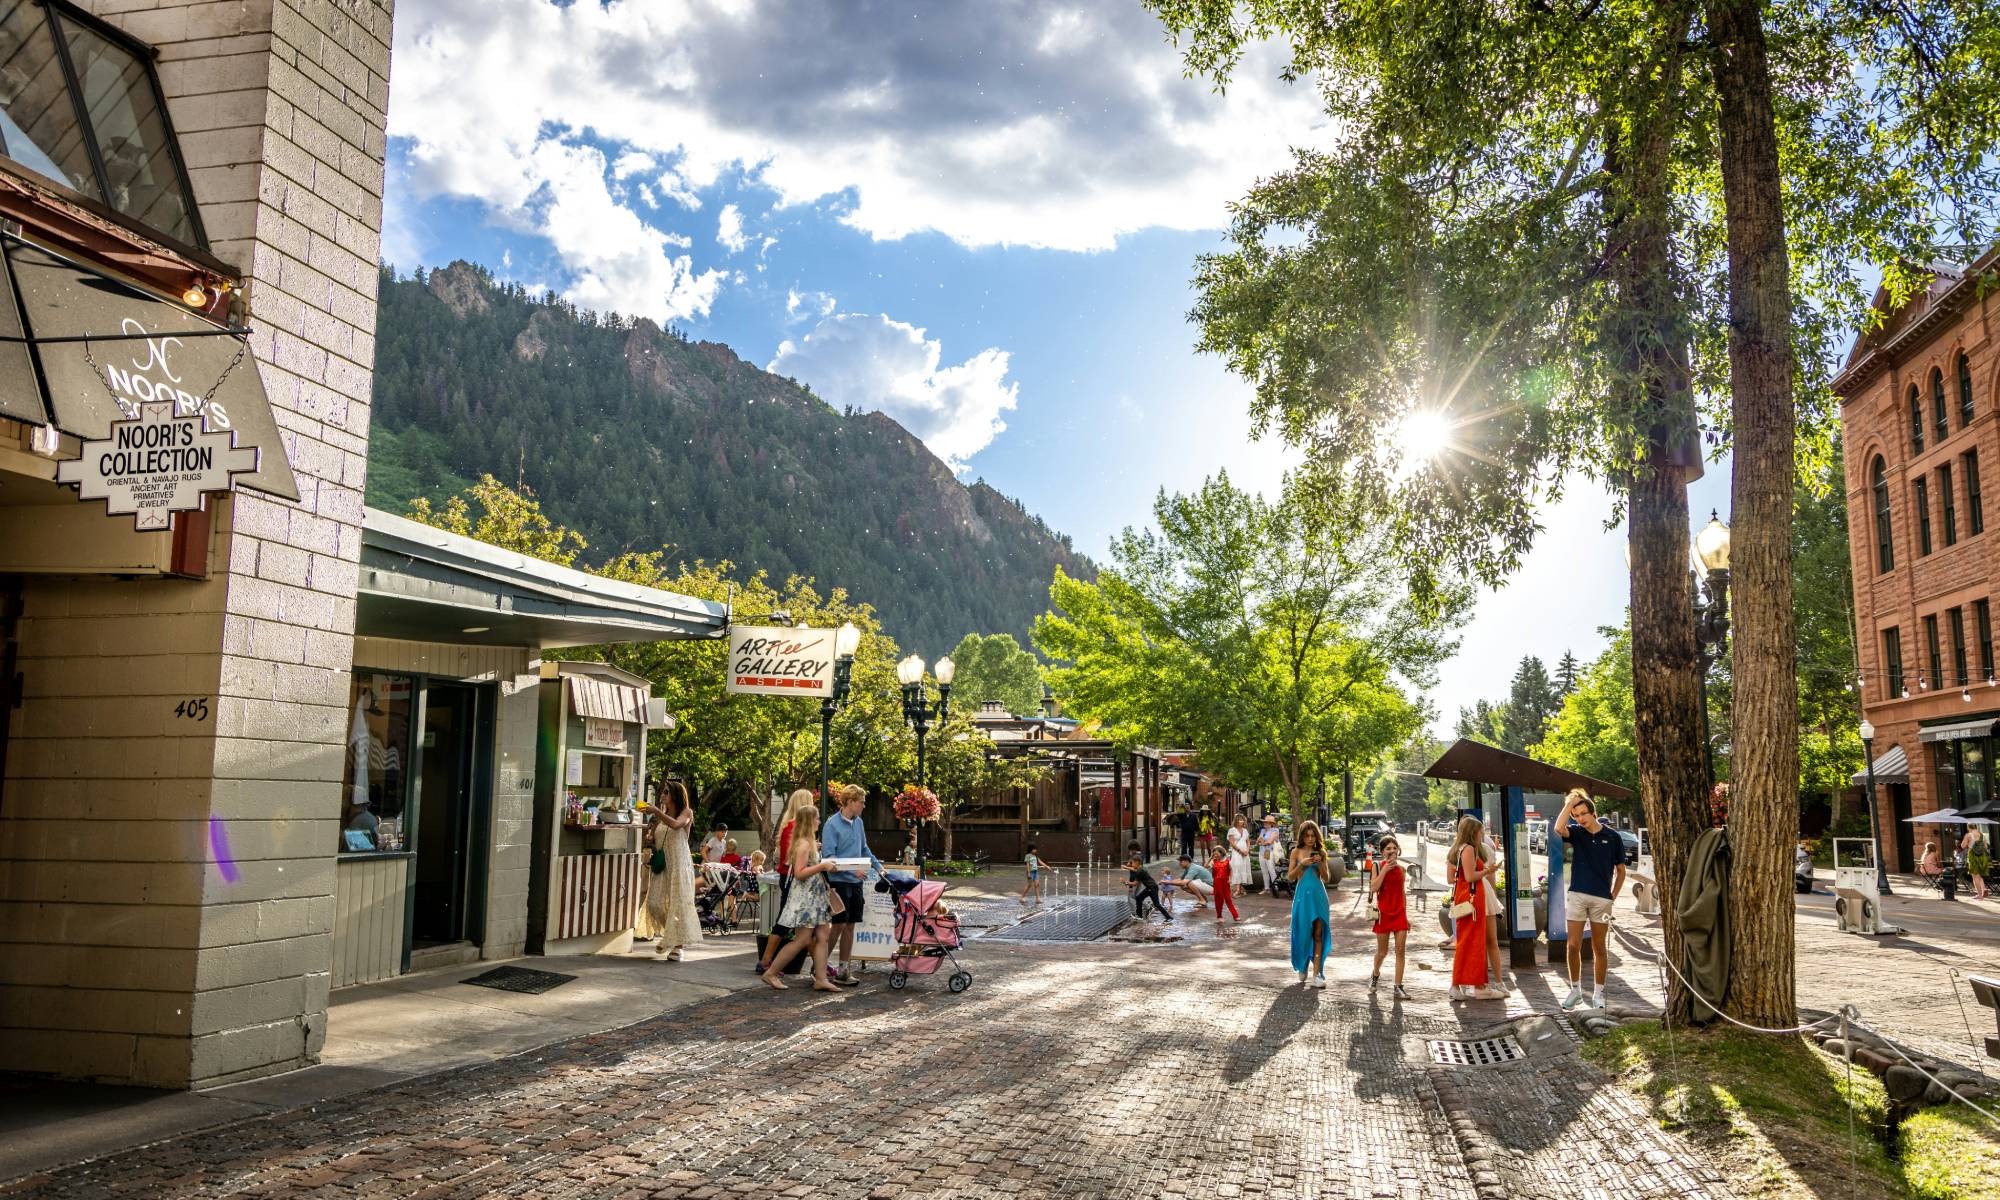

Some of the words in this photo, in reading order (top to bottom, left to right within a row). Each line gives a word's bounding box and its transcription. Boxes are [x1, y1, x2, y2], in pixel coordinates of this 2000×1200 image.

[118, 423, 194, 449] NOORI'S
[100, 447, 212, 477] COLLECTION
[107, 477, 140, 487] ORIENTAL
[143, 476, 149, 484] &
[152, 474, 179, 483] NAVAJO
[182, 473, 202, 481] RUGS
[130, 483, 160, 492] ANCIENT
[133, 491, 174, 500] PRIMATIVES
[136, 499, 170, 508] JEWELRY
[734, 657, 829, 677] GALLERY
[738, 677, 820, 688] ASPEN
[174, 697, 208, 721] 405
[520, 778, 533, 790] 401
[856, 931, 893, 945] HAPPY
